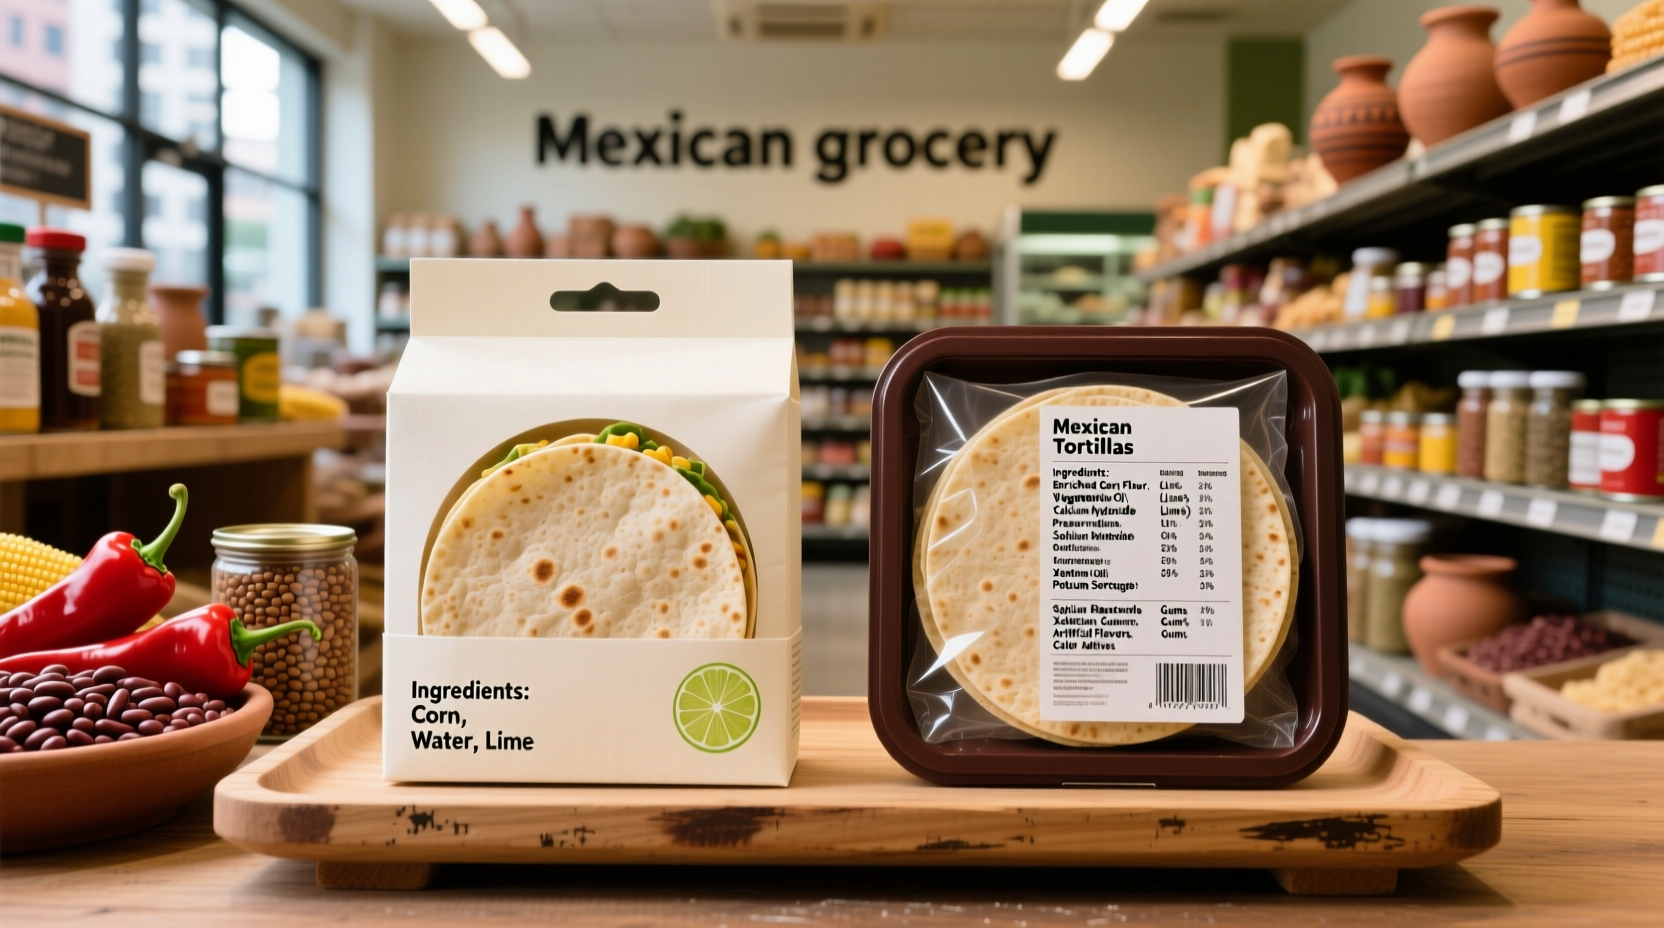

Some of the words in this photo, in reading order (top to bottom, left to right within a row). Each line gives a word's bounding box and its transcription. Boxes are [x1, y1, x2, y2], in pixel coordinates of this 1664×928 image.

[535, 109, 796, 169] Mexican
[813, 126, 1059, 187] grocery
[1053, 418, 1132, 435] Mexican
[1052, 437, 1134, 455] Tortillas
[411, 680, 530, 705] Ingredients:
[411, 705, 467, 729] Corn,
[411, 730, 479, 754] Water,
[485, 731, 535, 751] Lime
